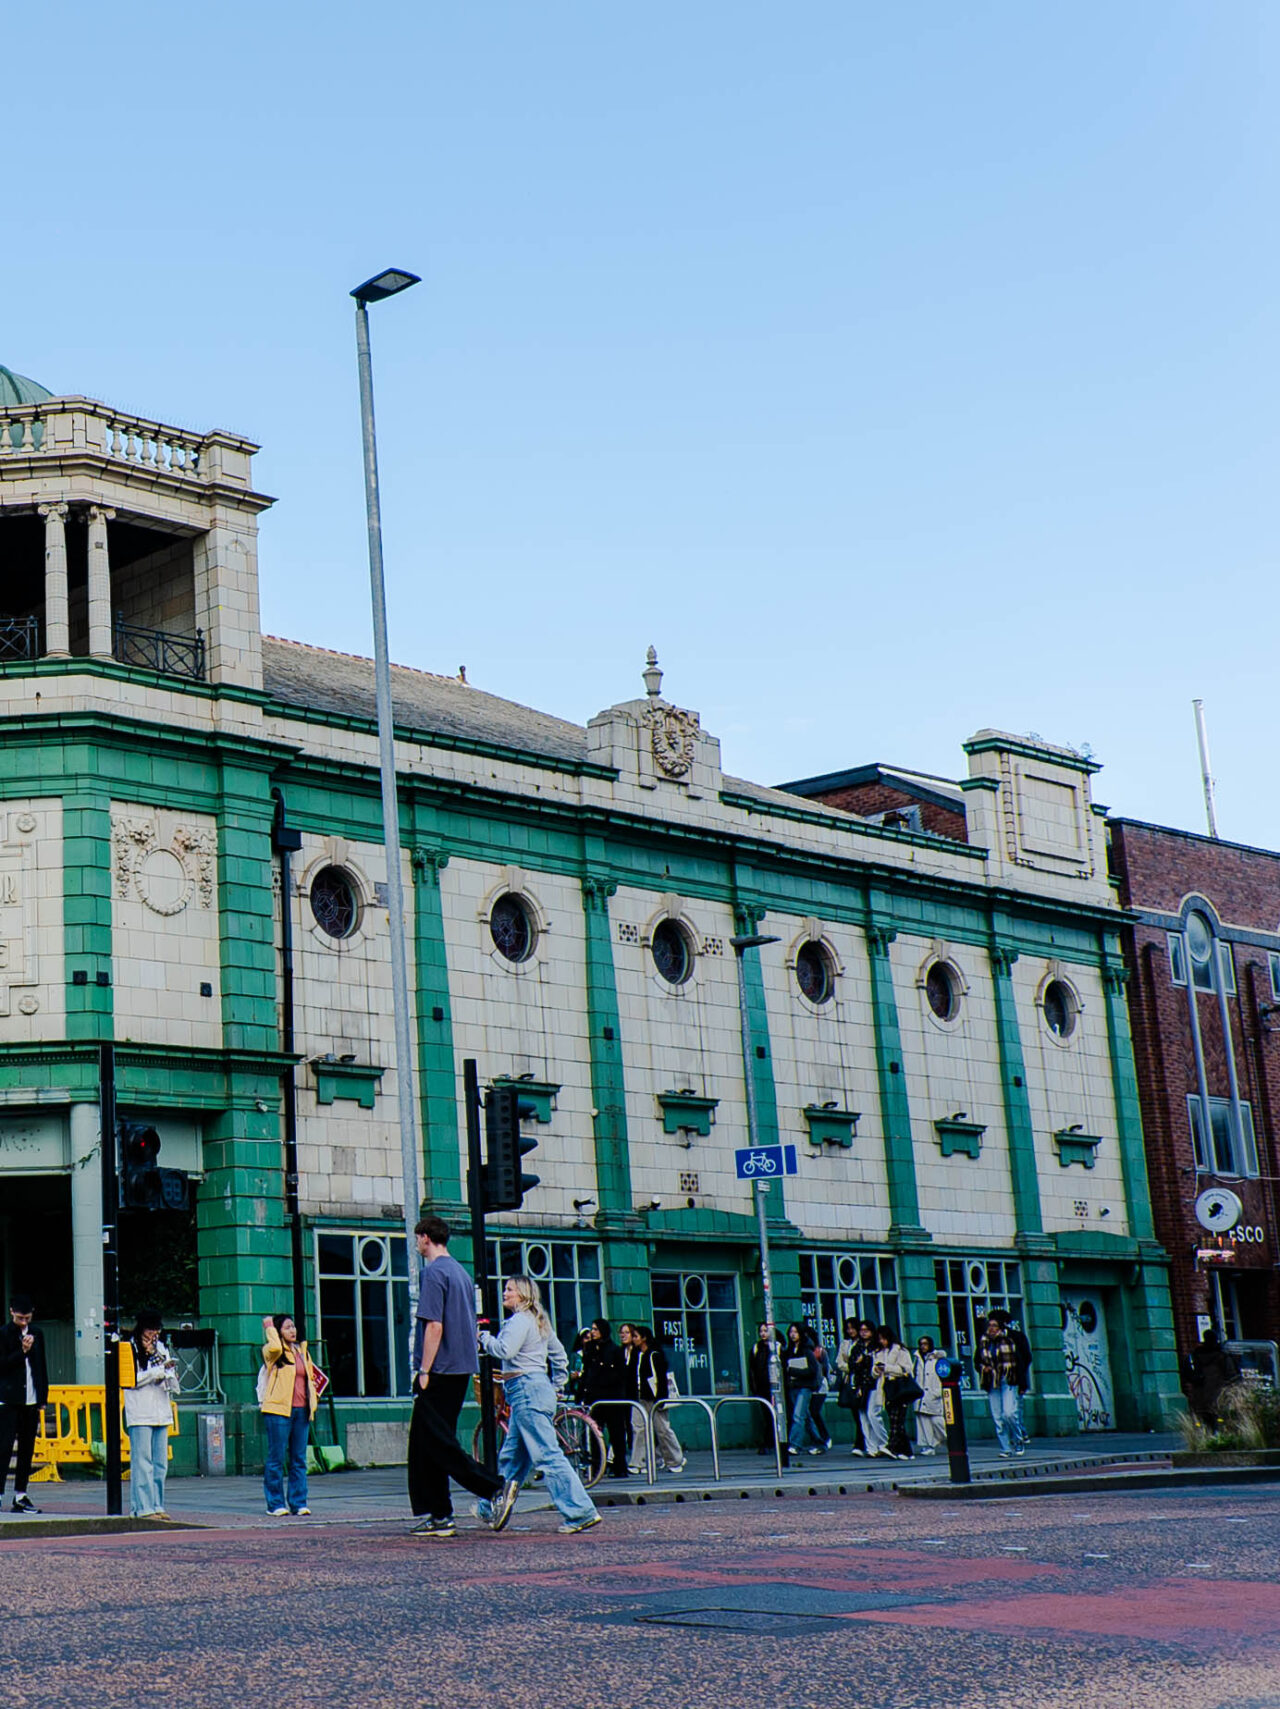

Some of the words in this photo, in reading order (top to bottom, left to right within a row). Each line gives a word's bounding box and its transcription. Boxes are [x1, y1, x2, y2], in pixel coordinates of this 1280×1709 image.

[663, 1321, 682, 1336] FAST
[674, 1337, 696, 1352] FREE
[688, 1353, 708, 1368] WI-FI
